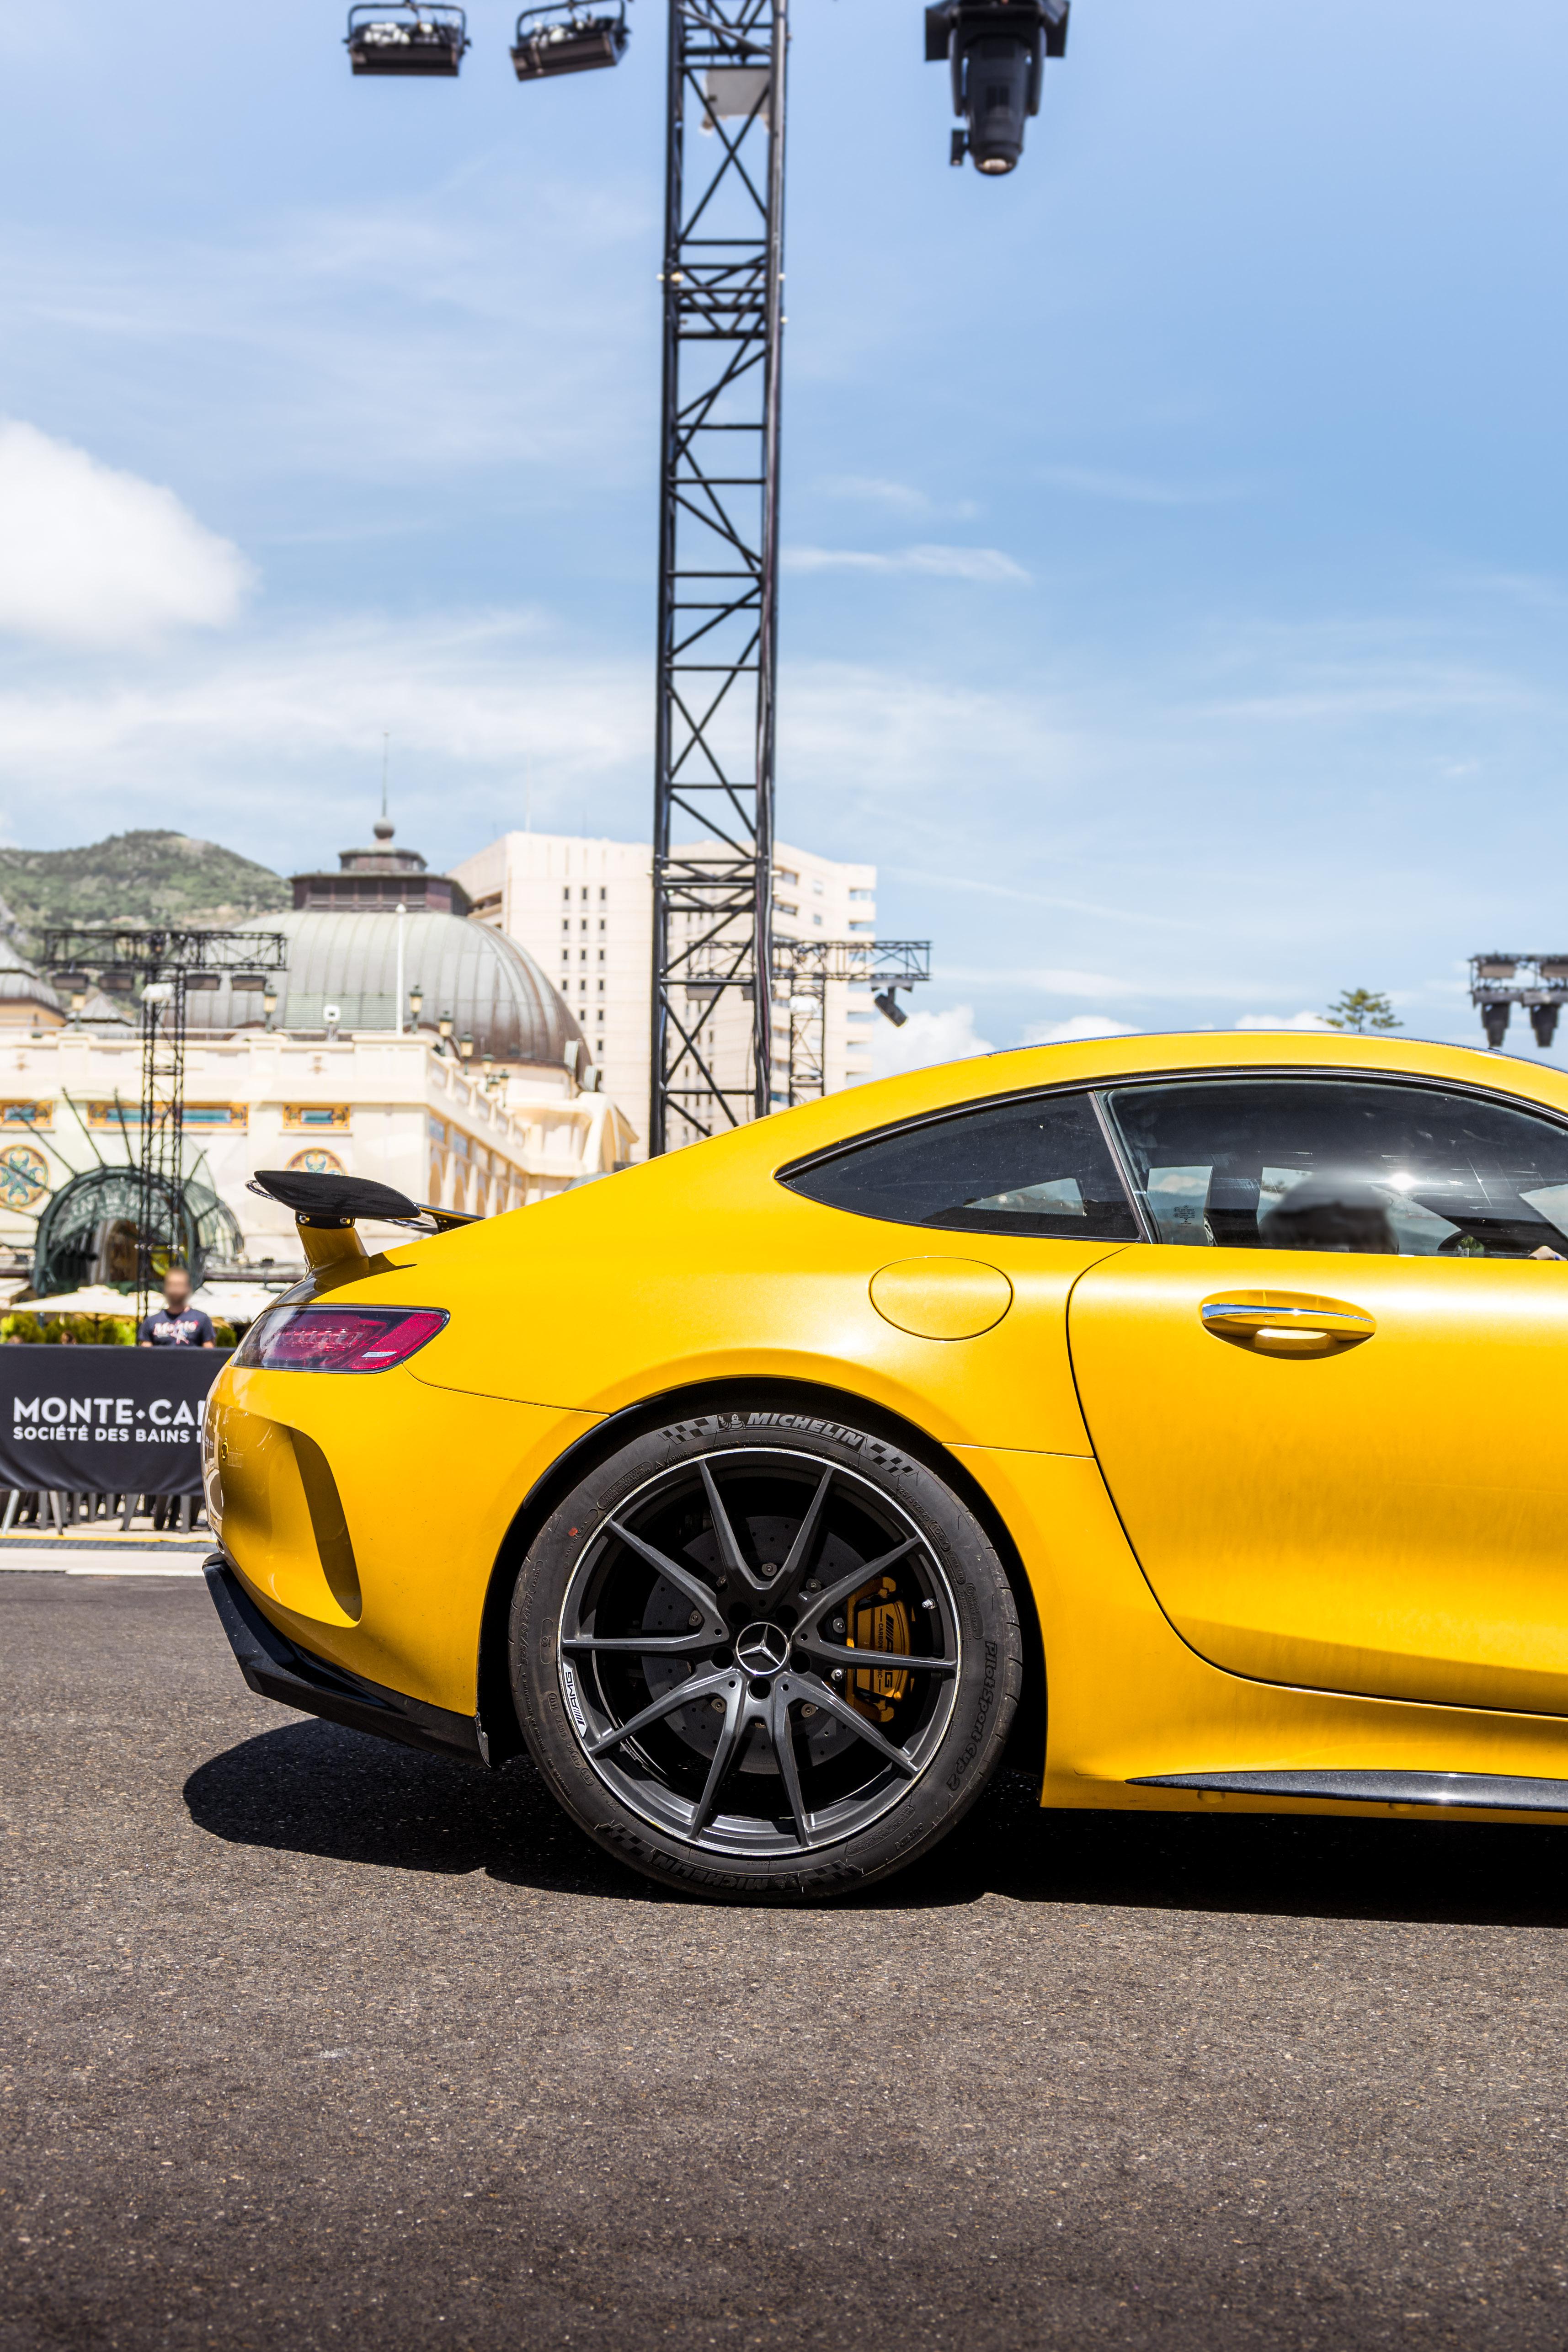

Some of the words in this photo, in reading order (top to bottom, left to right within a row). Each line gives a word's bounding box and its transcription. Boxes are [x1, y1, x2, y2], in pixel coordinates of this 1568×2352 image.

[13, 1424, 89, 1440] SOCIÉTÉ
[95, 1427, 129, 1442] DES
[135, 1429, 191, 1443] BAINS
[747, 1413, 863, 1446] MICHELIN
[984, 1640, 997, 1687] Pilot
[971, 1691, 994, 1742] Sport
[956, 1742, 977, 1775] Cup
[946, 1776, 959, 1792] 2
[652, 1855, 768, 1890] MICHELIN
